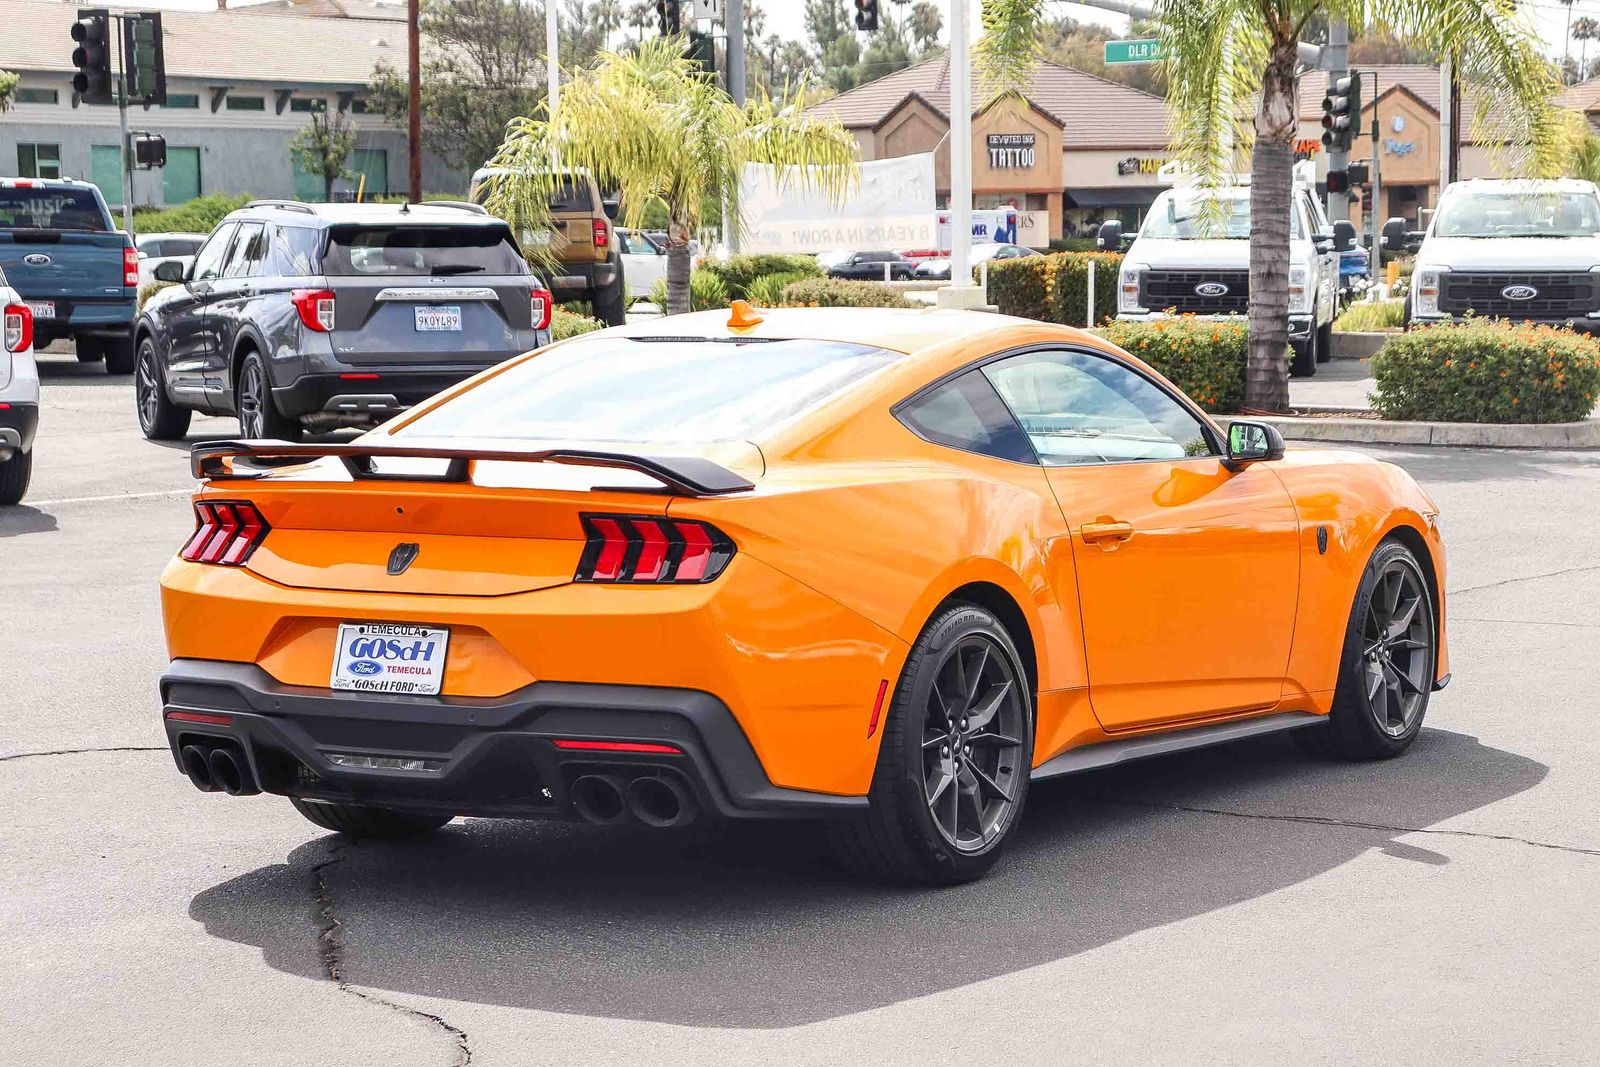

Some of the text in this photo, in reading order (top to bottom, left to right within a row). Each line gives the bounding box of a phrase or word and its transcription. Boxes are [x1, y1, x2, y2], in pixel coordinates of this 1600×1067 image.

[1128, 44, 1148, 57] DLR
[990, 148, 1035, 167] TATTOO
[366, 624, 420, 636] TEMECULA
[354, 662, 432, 675] Ford TEMECULA
[390, 681, 414, 692] FORD
